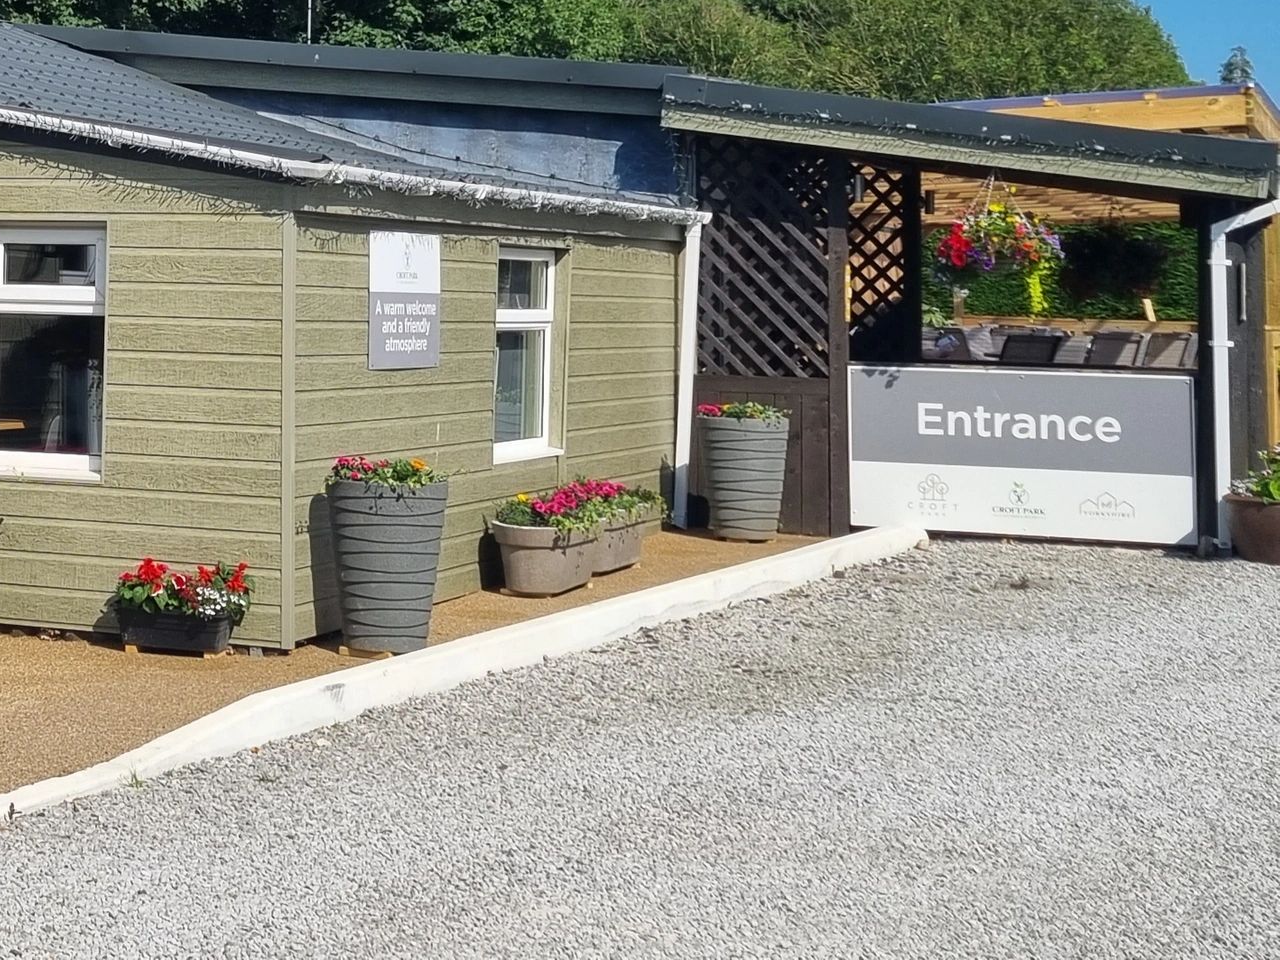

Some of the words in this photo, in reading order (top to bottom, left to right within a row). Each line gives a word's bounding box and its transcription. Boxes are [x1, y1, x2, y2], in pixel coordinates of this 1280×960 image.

[375, 300, 382, 315] A
[383, 302, 405, 315] warm
[406, 300, 437, 315] welcome
[382, 318, 397, 333] and
[398, 321, 404, 333] a
[404, 318, 431, 335] friendly
[385, 337, 428, 354] atmosphere
[918, 402, 1122, 443] Entrance
[907, 501, 958, 512] CROFT
[992, 506, 1020, 514] CROFT
